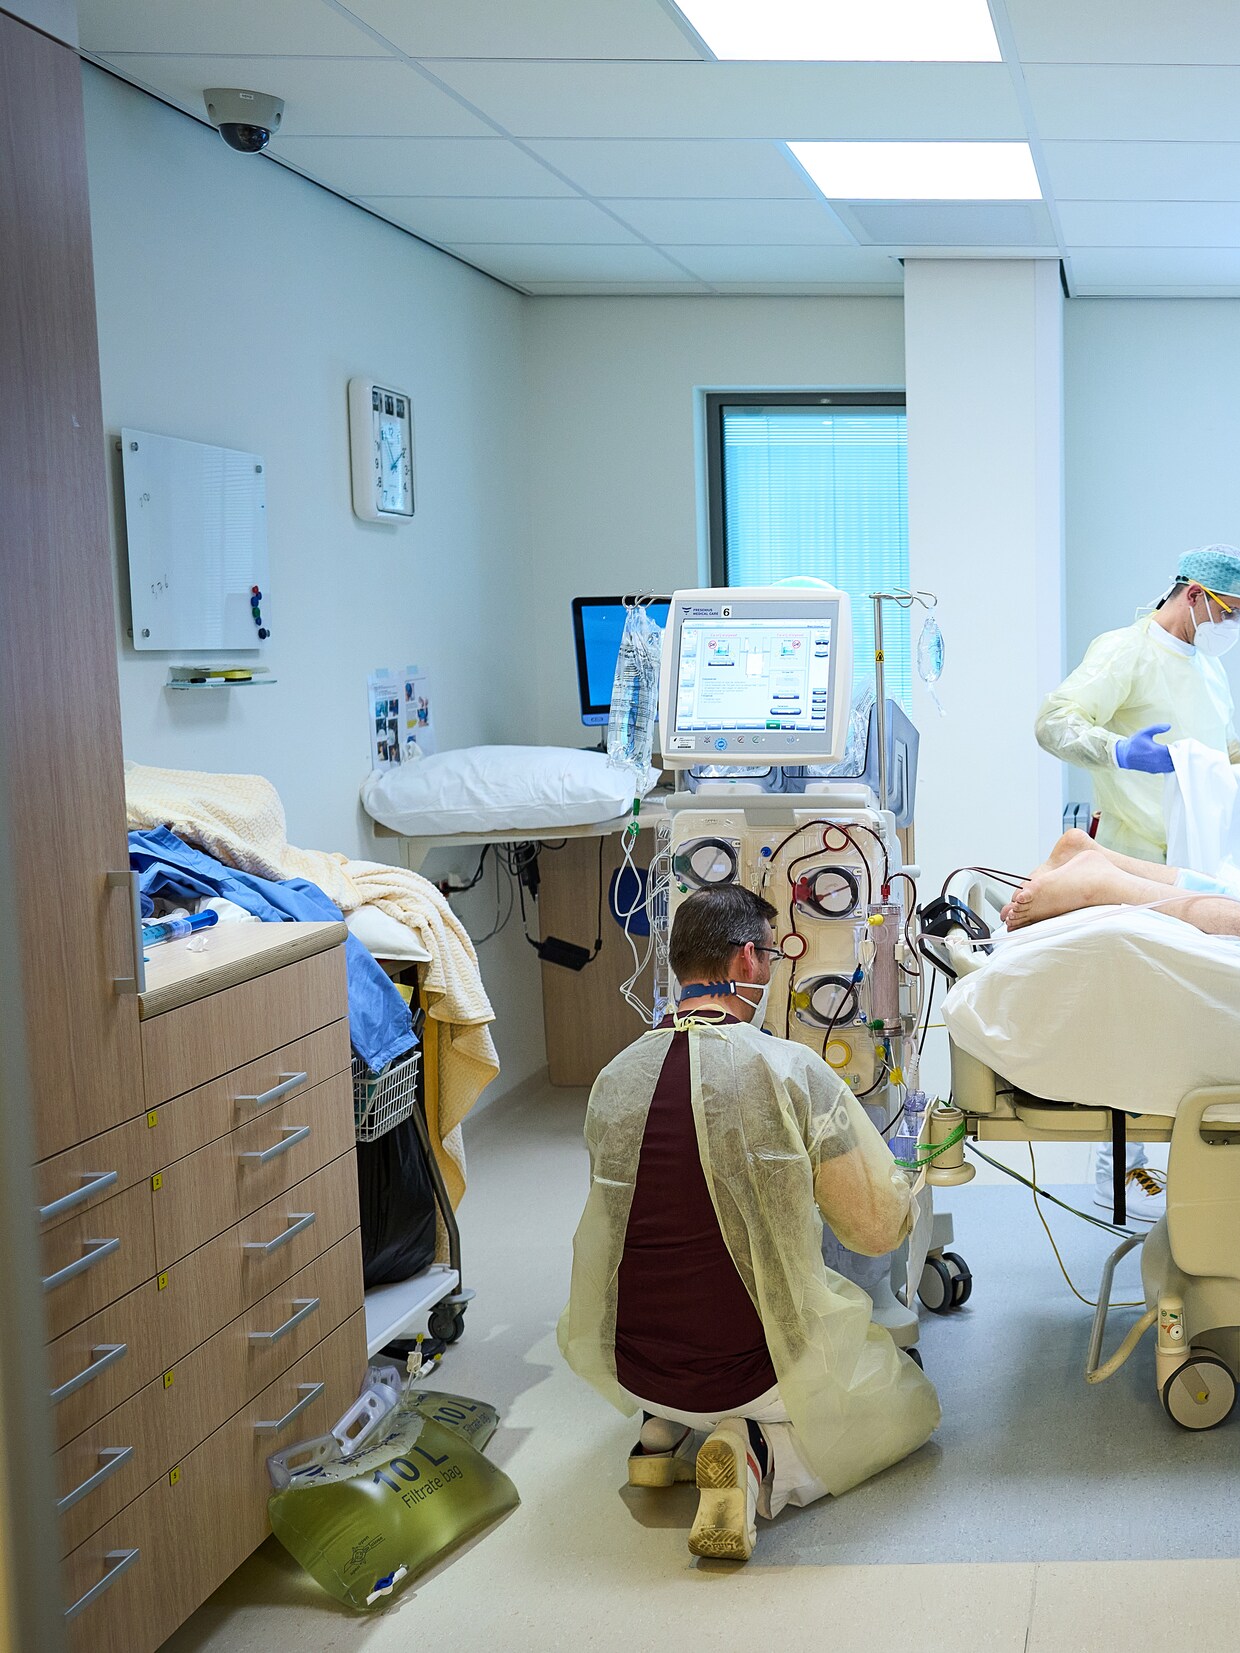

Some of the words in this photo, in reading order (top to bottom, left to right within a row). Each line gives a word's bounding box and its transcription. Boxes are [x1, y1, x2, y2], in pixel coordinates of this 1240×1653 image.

[723, 607, 730, 617] 6
[448, 1401, 477, 1412] L
[433, 1407, 466, 1425] 10
[372, 1457, 421, 1493] 10
[412, 1446, 450, 1467] L
[401, 1476, 444, 1509] Filtrate
[440, 1465, 463, 1482] bag
[358, 1535, 370, 1546] open
